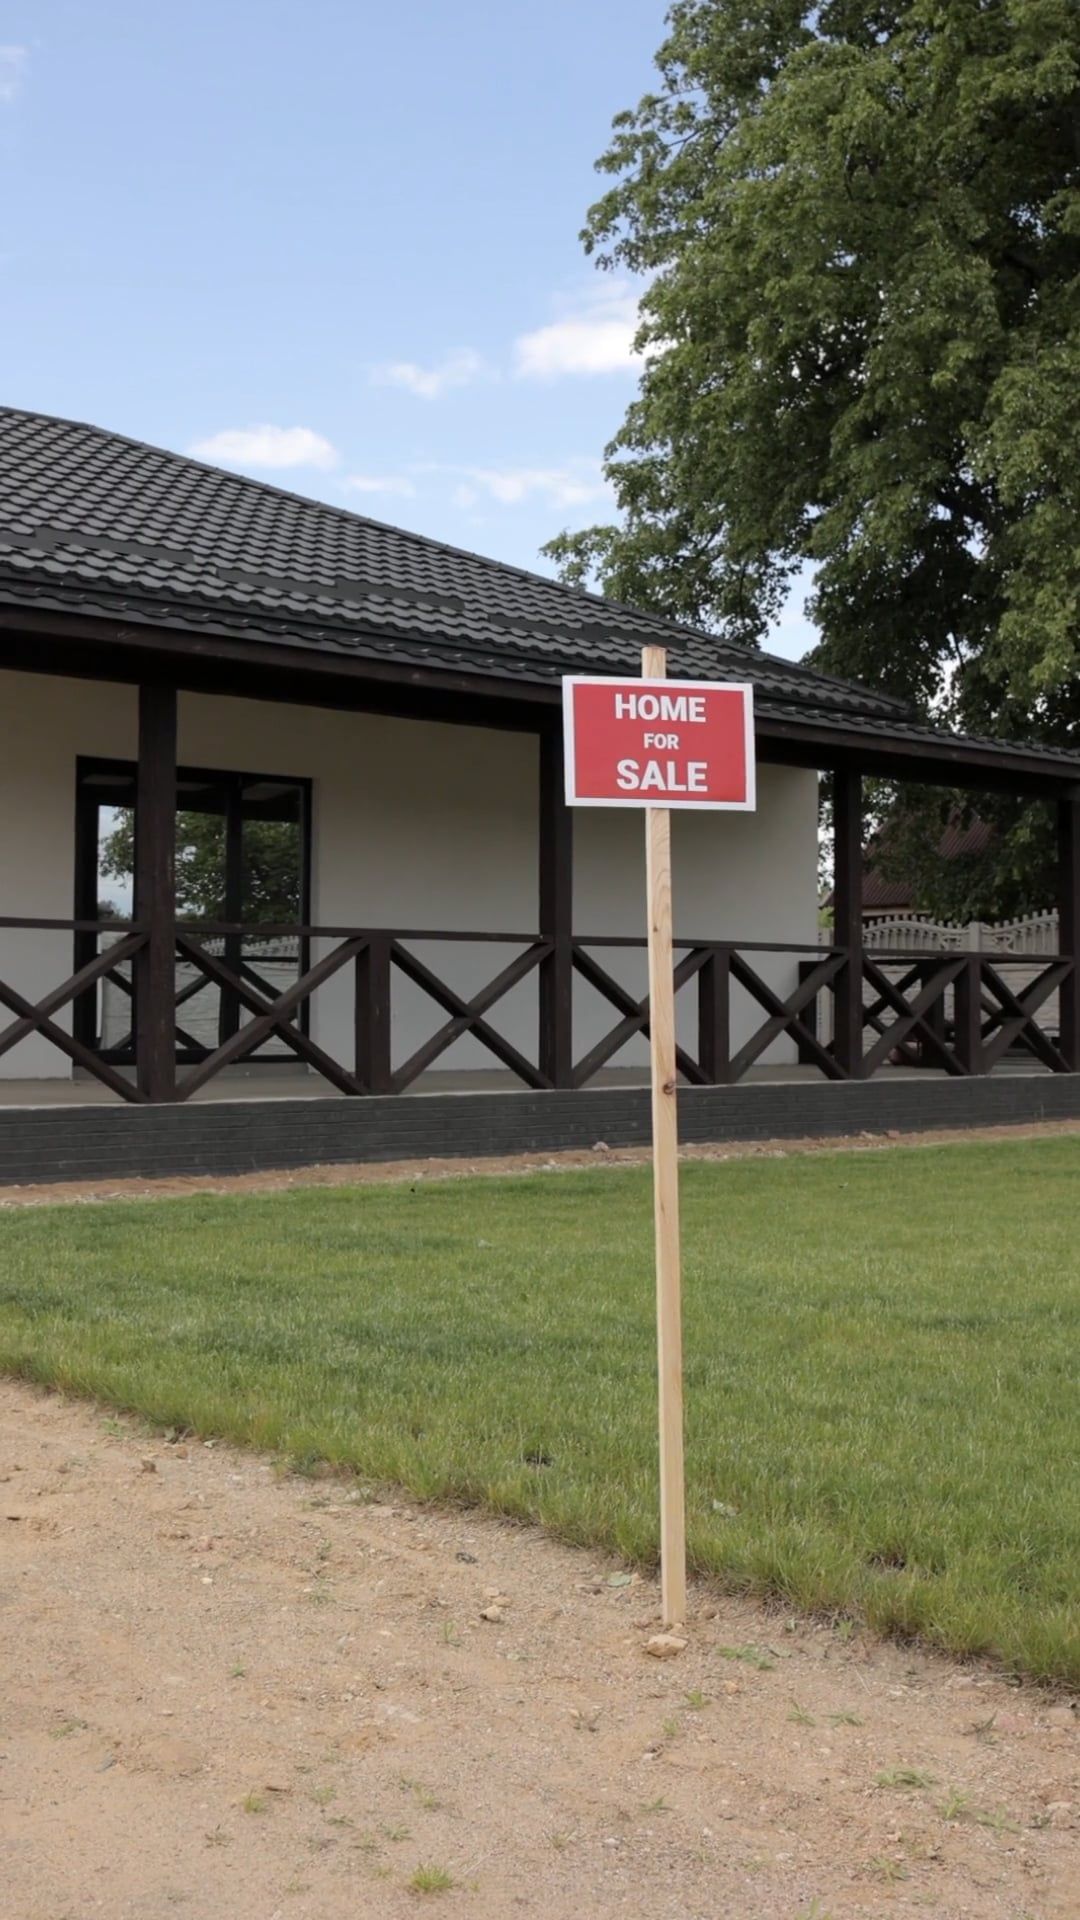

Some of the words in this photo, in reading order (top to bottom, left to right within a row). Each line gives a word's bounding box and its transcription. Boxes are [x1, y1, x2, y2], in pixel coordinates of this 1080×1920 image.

[614, 694, 706, 723] HOME
[643, 733, 679, 750] FOR
[616, 759, 708, 792] SALE
